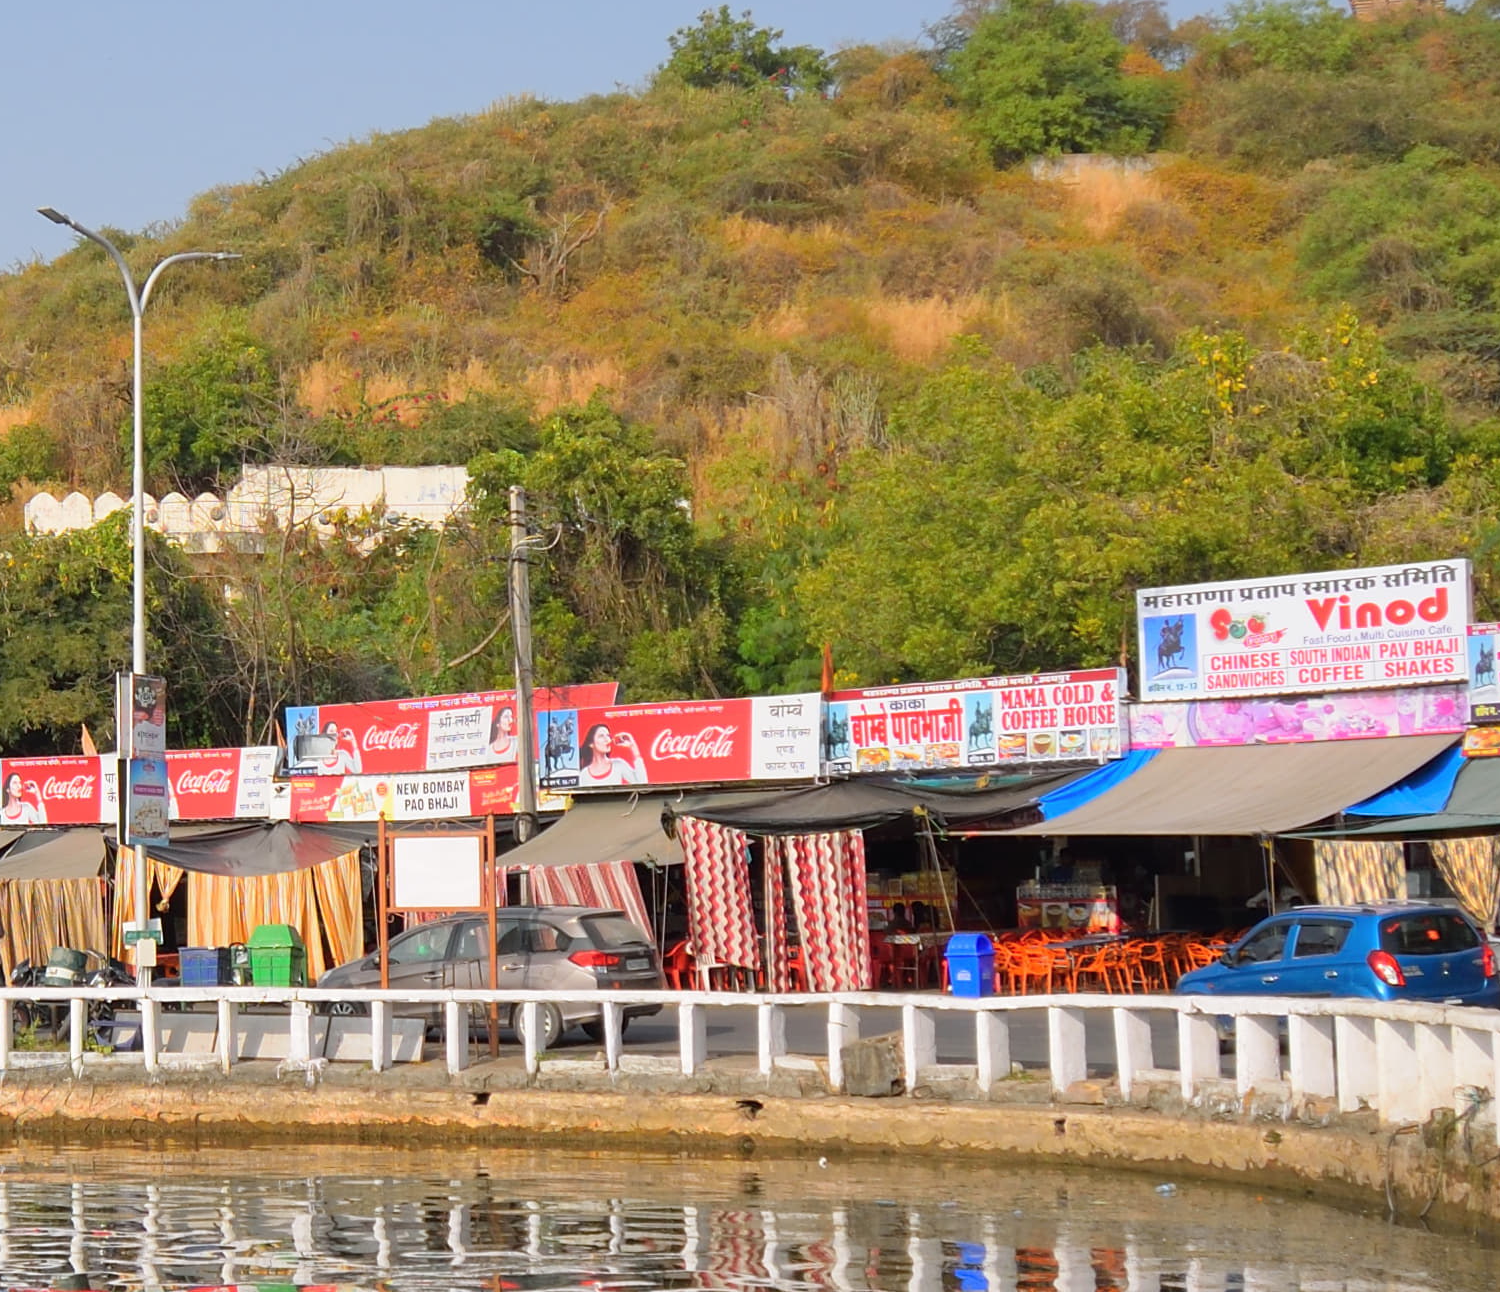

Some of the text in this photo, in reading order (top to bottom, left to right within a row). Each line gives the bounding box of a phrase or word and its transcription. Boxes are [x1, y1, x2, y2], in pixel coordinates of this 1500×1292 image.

[1143, 565, 1457, 609] महाराणा प्रताप स्मारक समिति
[1305, 587, 1449, 633] Vinod
[1303, 634, 1324, 645] Fast
[1326, 633, 1351, 644] Food
[1360, 629, 1385, 641] Multi
[1387, 627, 1427, 640] Cuisine
[1428, 625, 1453, 636] Cafe
[1290, 645, 1371, 666] SOUTH INDIAN
[1379, 637, 1459, 659] PAV BHAJI
[1210, 652, 1281, 671] CHINESE
[1385, 658, 1455, 678] SHAKES
[1207, 670, 1285, 690] SANDWICHES
[1299, 665, 1364, 684] COFFEE
[889, 698, 926, 711] काका
[1001, 682, 1115, 710] MAMA COLD &
[769, 700, 805, 719] बोम्बे
[1002, 704, 1116, 731] COFFEE HOUSE
[850, 698, 963, 748] बोम्बे पावभाजी
[363, 723, 421, 752] Coca-Cola
[651, 725, 737, 761] Coca-Cola
[43, 775, 96, 799] Coca-Cola
[177, 769, 232, 795] Coca-Cola
[396, 779, 466, 796] NEW BOMBAY
[404, 796, 459, 811] PAO BHAJI
